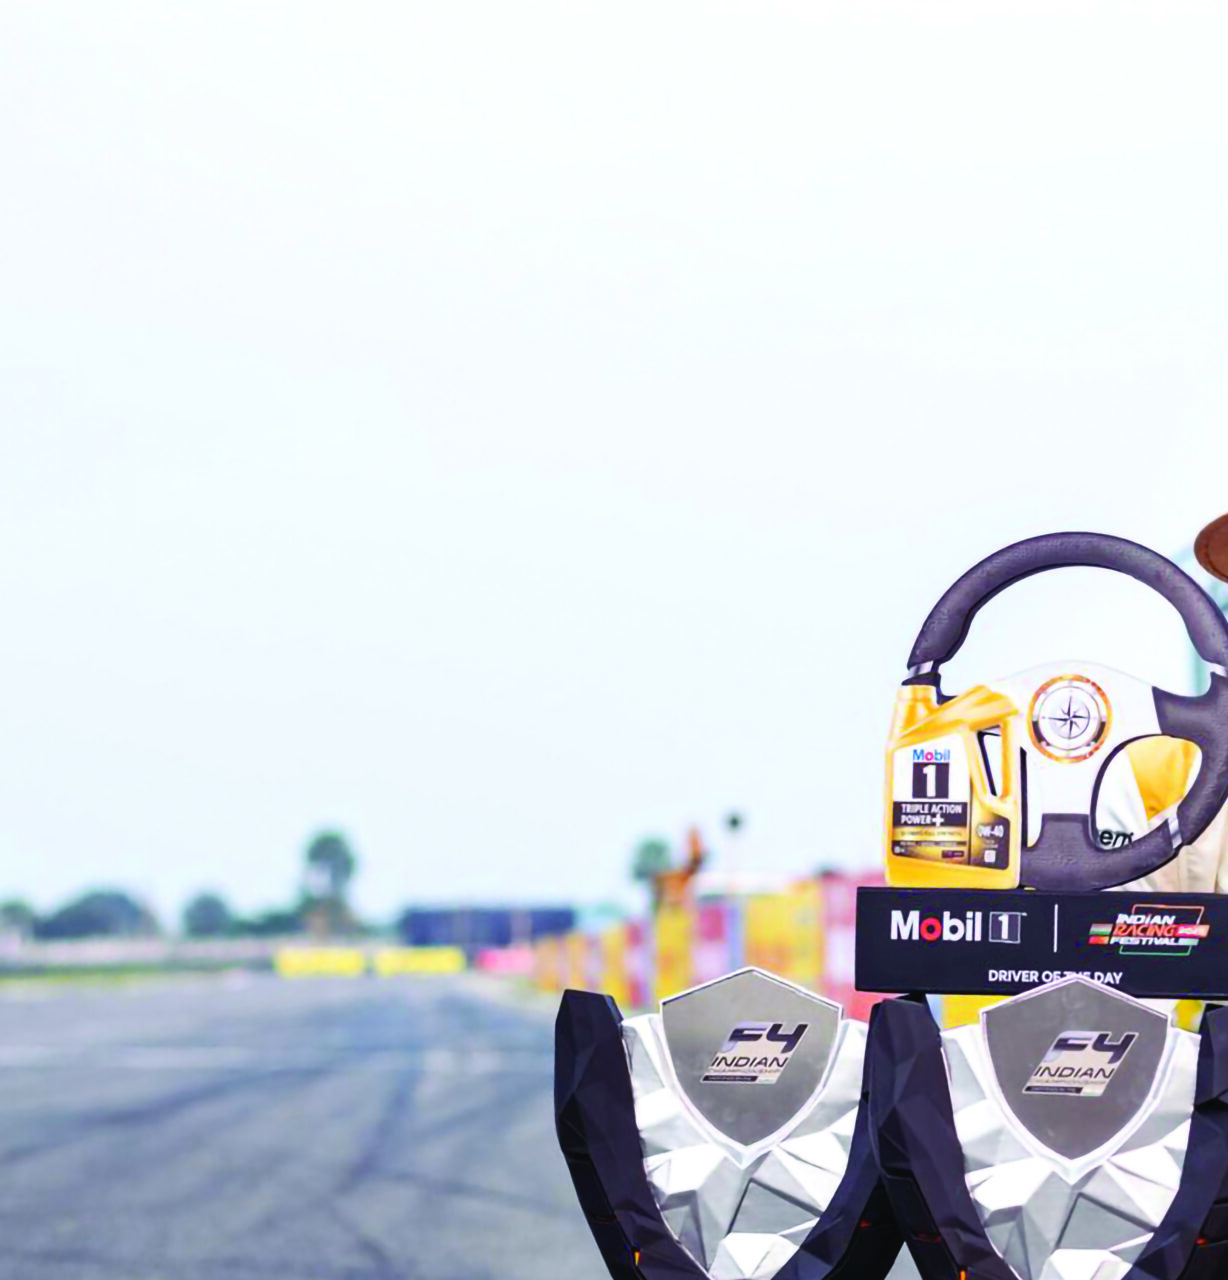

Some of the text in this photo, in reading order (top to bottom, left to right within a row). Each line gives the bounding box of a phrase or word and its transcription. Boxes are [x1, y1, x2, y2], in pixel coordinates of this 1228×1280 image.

[912, 748, 951, 761] Mobil
[922, 764, 937, 798] 1
[901, 803, 963, 815] TRIPLE ACTION
[890, 909, 1010, 942] Mobil 1
[1115, 913, 1177, 925] INDIAN
[1112, 924, 1176, 937] RACING
[1109, 937, 1182, 946] FESTIVAL
[987, 969, 1040, 983] DRIVER
[1041, 970, 1062, 984] OF
[1093, 971, 1123, 985] DAY
[721, 1021, 809, 1054] F4
[1043, 1030, 1140, 1066] F4
[710, 1055, 790, 1069] INDIAN
[1033, 1065, 1117, 1080] INDIAN
